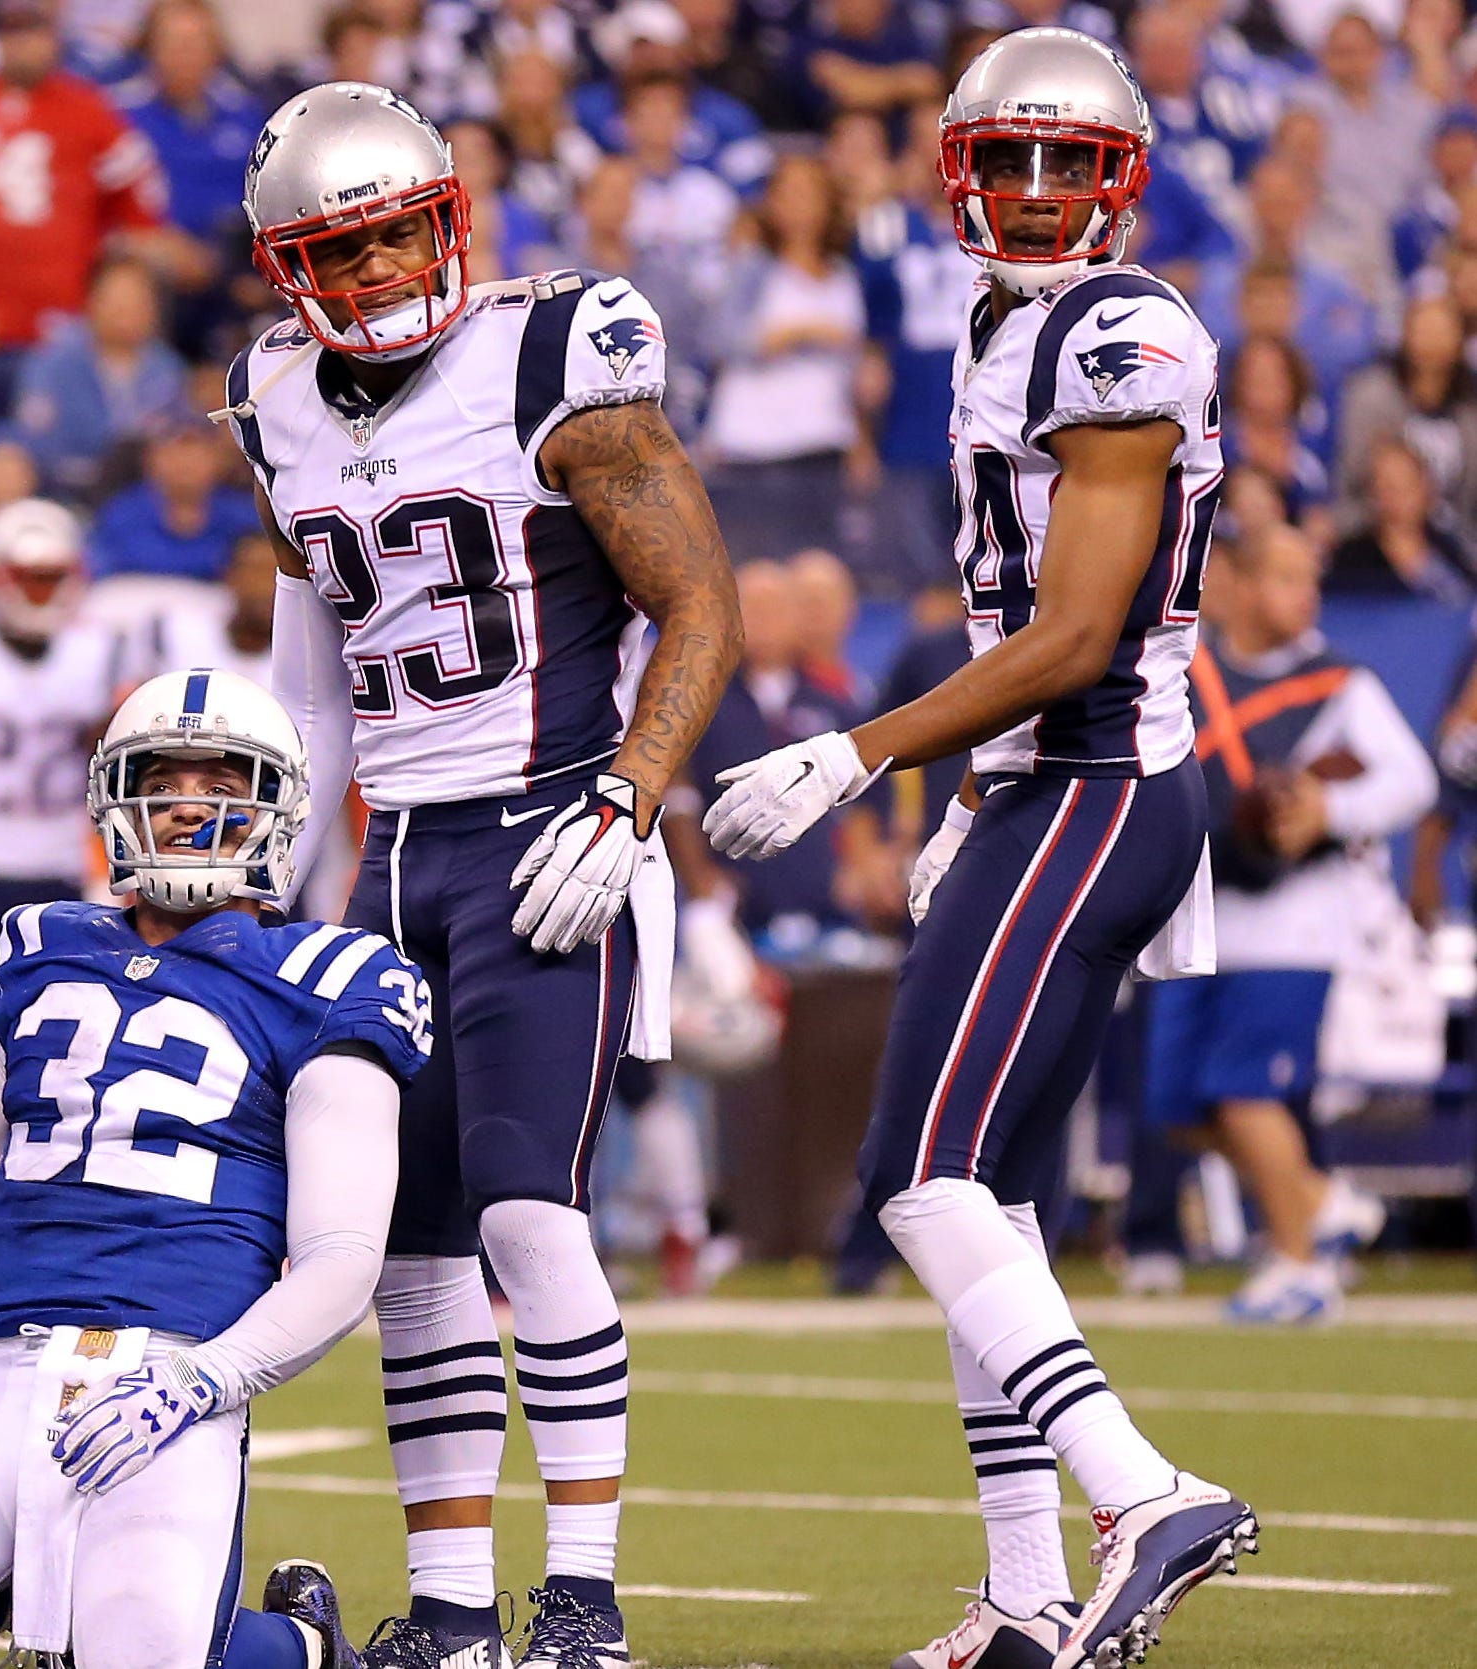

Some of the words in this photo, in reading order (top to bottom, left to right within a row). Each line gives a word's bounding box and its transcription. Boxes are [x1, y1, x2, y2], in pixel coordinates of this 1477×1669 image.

[337, 181, 380, 205] PATRIOTS
[340, 458, 397, 485] PATRIOTS
[289, 487, 527, 720] 23
[379, 968, 435, 1057] 32
[3, 982, 251, 1205] 32
[439, 1639, 492, 1669] NIKE
